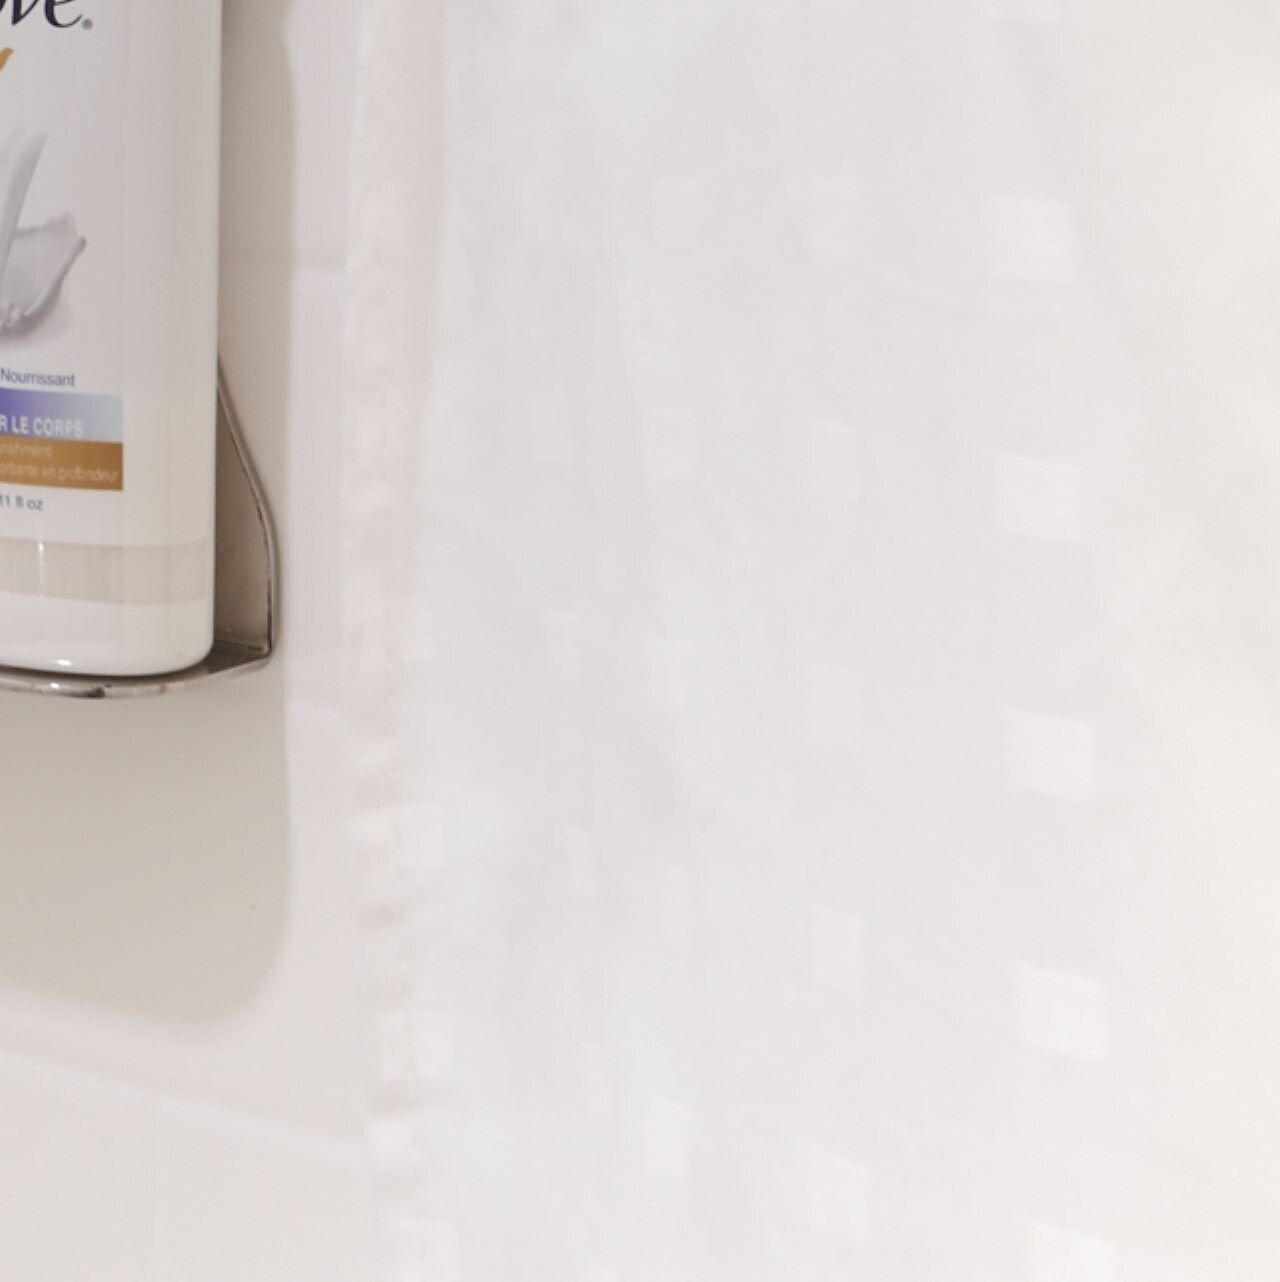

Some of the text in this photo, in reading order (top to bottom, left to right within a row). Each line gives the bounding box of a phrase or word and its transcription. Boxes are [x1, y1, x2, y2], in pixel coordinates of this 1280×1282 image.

[0, 368, 76, 387] Nourrissant
[11, 415, 29, 434] LE
[32, 417, 85, 438] CORPS
[57, 464, 120, 484] profondeur
[26, 498, 44, 511] oz
